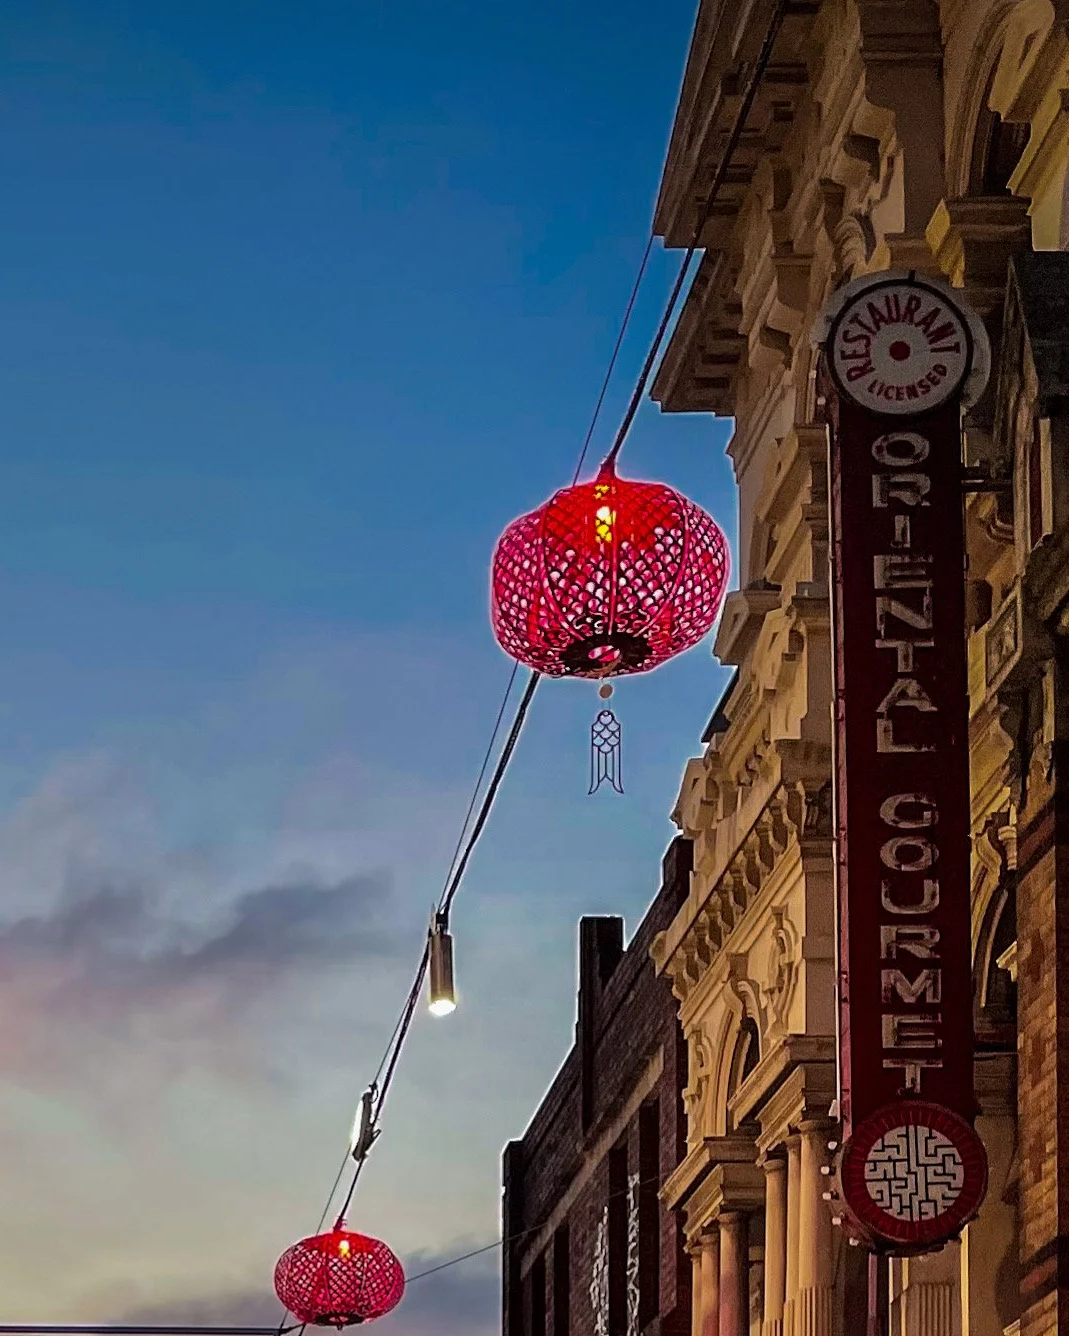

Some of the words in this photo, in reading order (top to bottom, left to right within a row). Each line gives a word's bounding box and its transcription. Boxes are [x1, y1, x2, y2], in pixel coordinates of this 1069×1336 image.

[840, 294, 961, 383] RESTAURANT
[867, 363, 948, 402] LICENSED
[872, 432, 938, 754] ORIENTAL
[878, 793, 943, 1095] GOURMET
